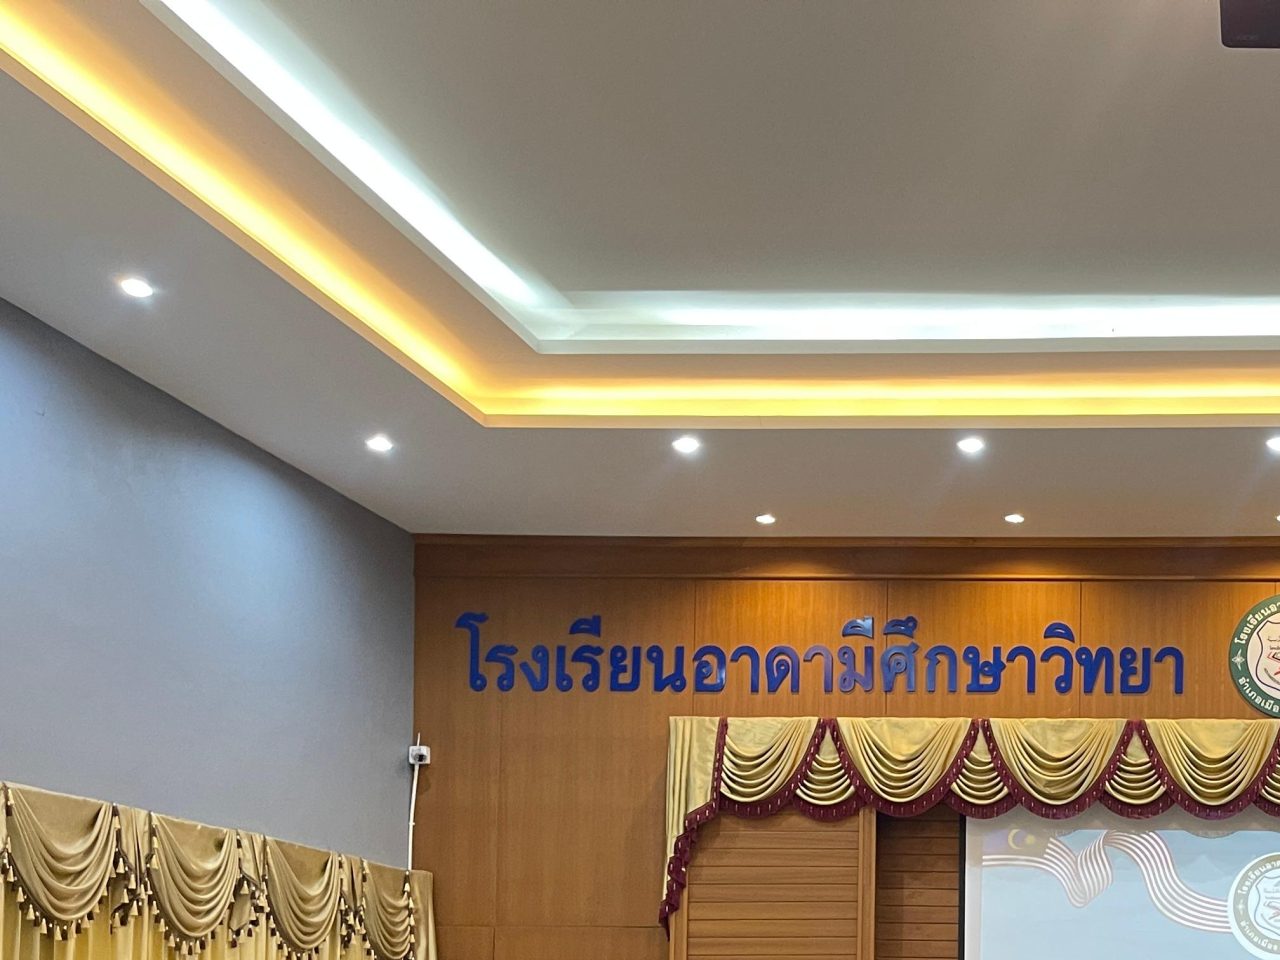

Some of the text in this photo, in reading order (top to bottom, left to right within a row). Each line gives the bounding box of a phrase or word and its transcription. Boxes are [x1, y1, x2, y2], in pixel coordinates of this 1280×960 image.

[455, 613, 1185, 695] โรงเรียนอาดามีศึกษาวิทยา
